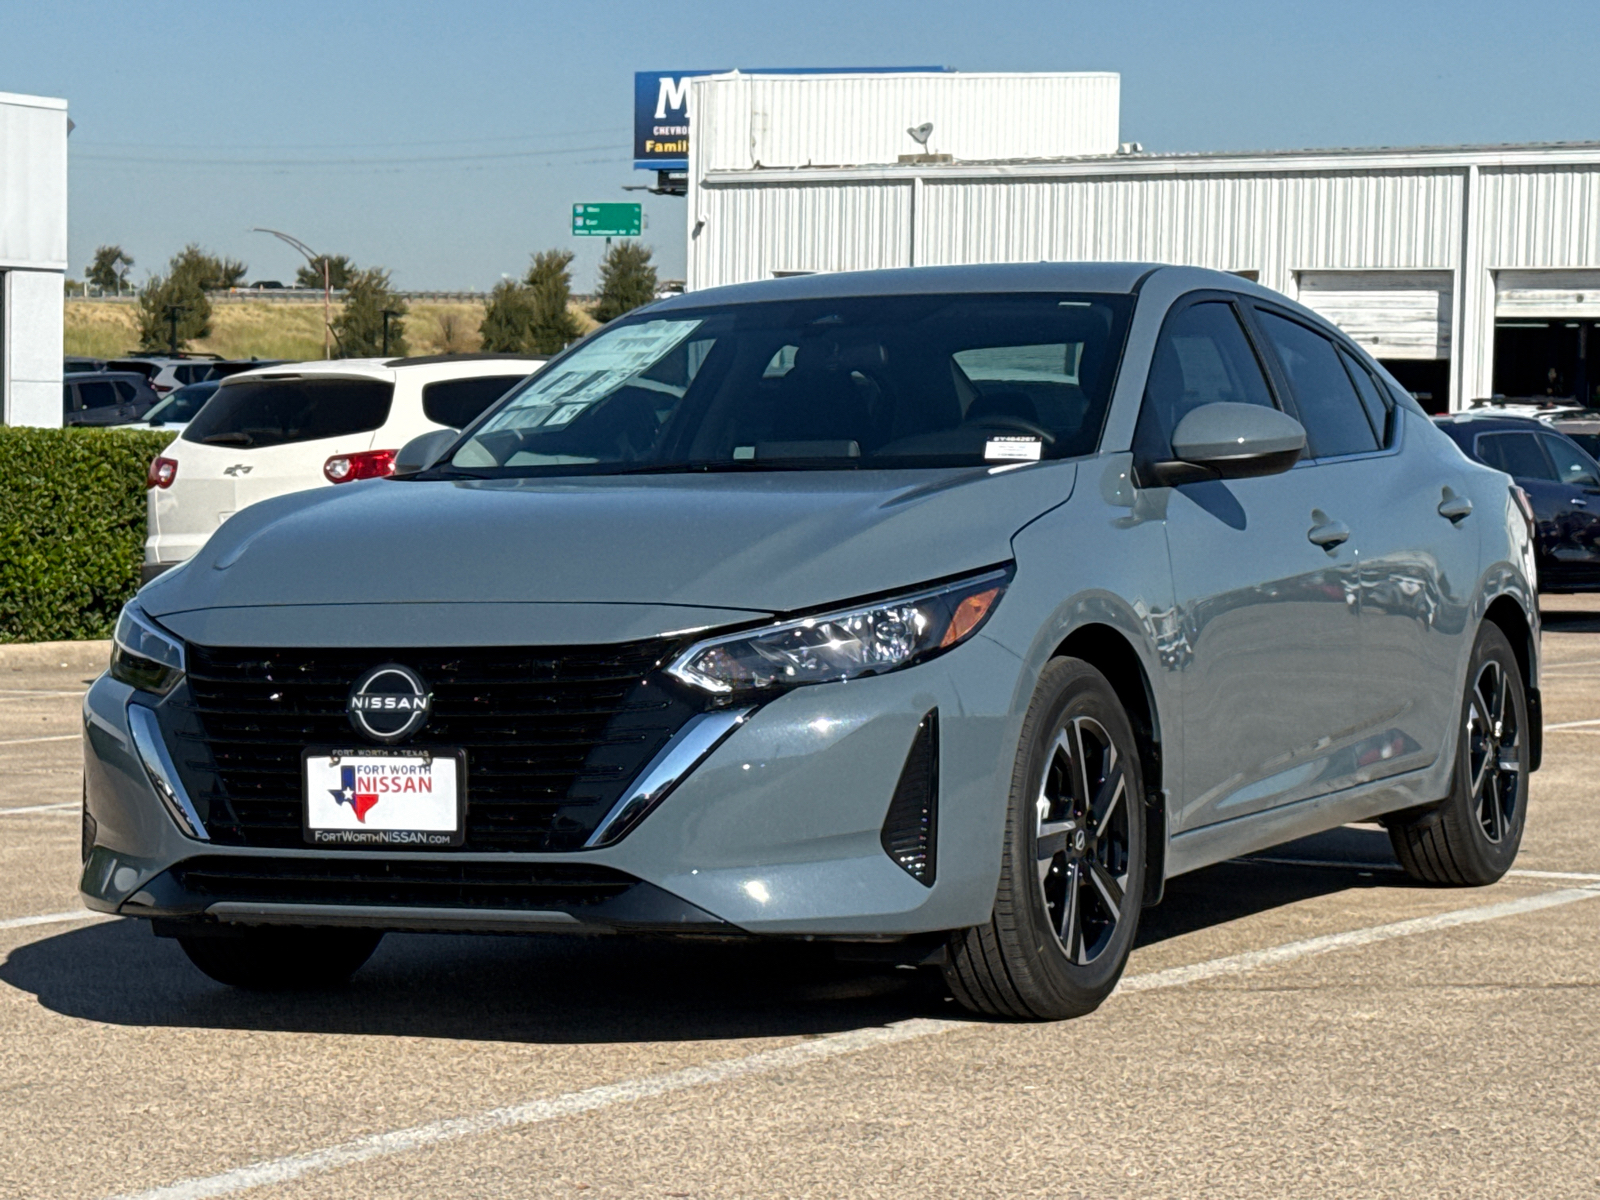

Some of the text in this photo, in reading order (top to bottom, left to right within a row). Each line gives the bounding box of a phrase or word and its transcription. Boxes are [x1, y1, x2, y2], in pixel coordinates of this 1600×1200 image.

[653, 126, 690, 136] CHEVRO
[351, 696, 427, 709] NISSAN
[401, 749, 429, 757] TEXAS
[357, 765, 432, 775] FORT WORTH
[357, 776, 432, 793] NISSAN
